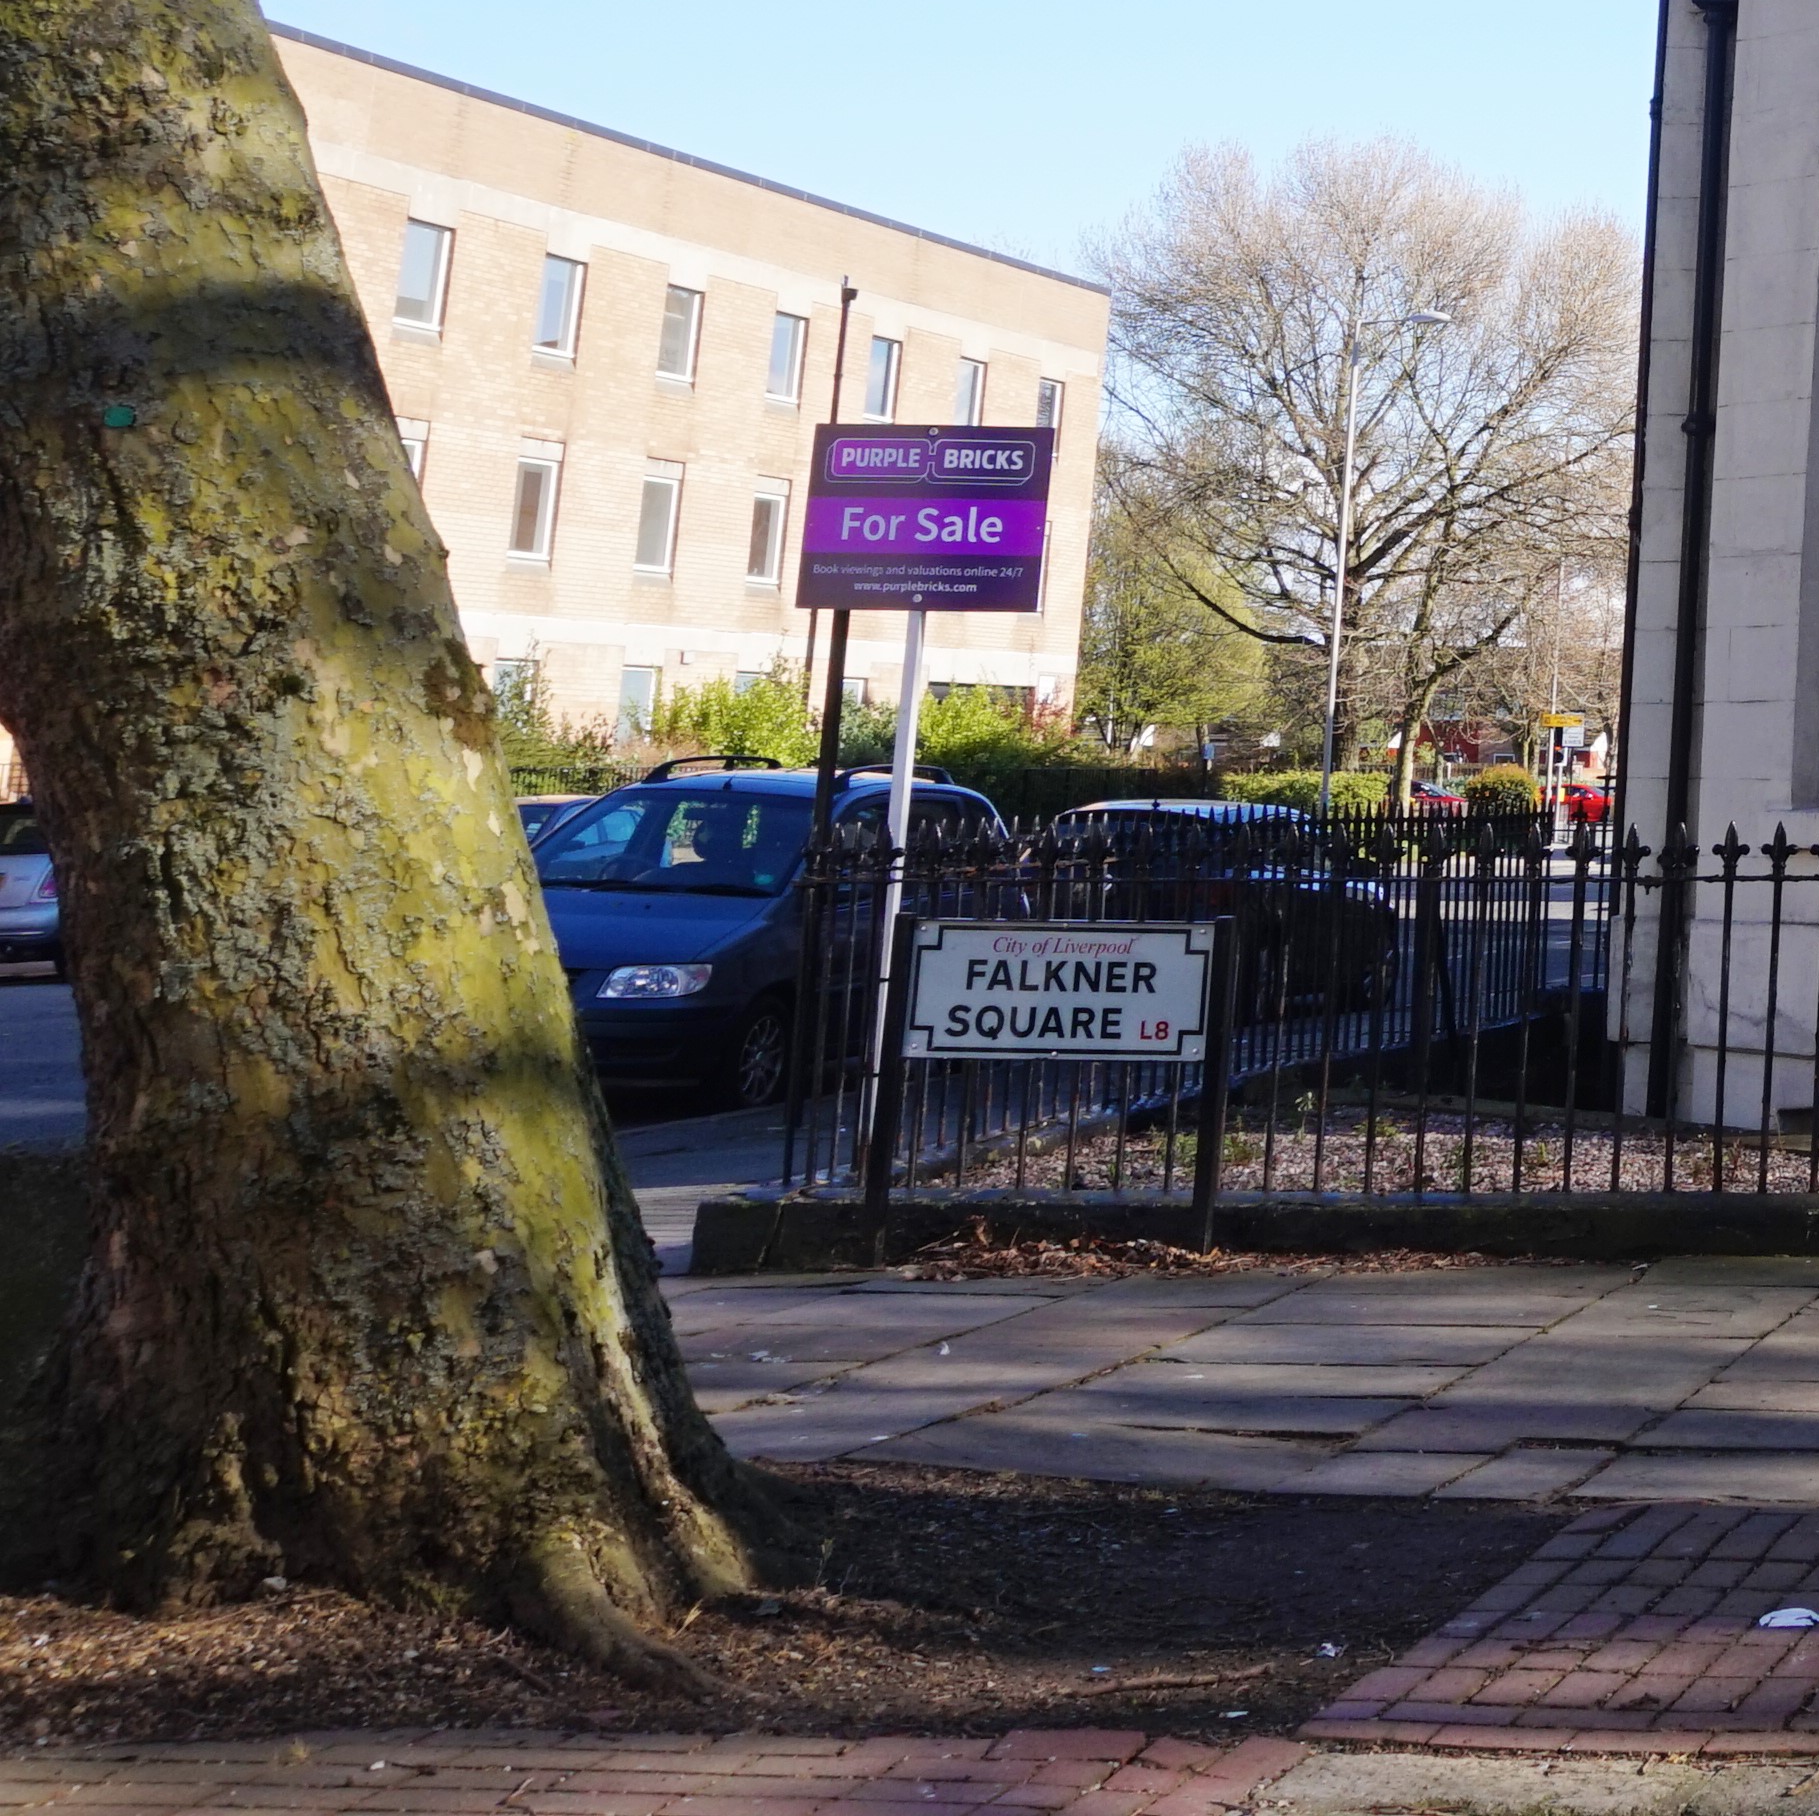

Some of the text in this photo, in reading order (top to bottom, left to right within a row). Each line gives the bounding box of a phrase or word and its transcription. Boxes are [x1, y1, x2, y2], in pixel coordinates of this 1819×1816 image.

[841, 447, 1024, 470] PURPLE BRICKS
[841, 506, 1003, 543] For Sale
[813, 564, 1024, 578] Book viewings and valuations online 24/7
[853, 581, 977, 593] www.purplebricks.com
[992, 936, 1135, 958] City of Liverpool
[966, 959, 1157, 994] FALKNER
[944, 1004, 1169, 1041] SQUARE L8
